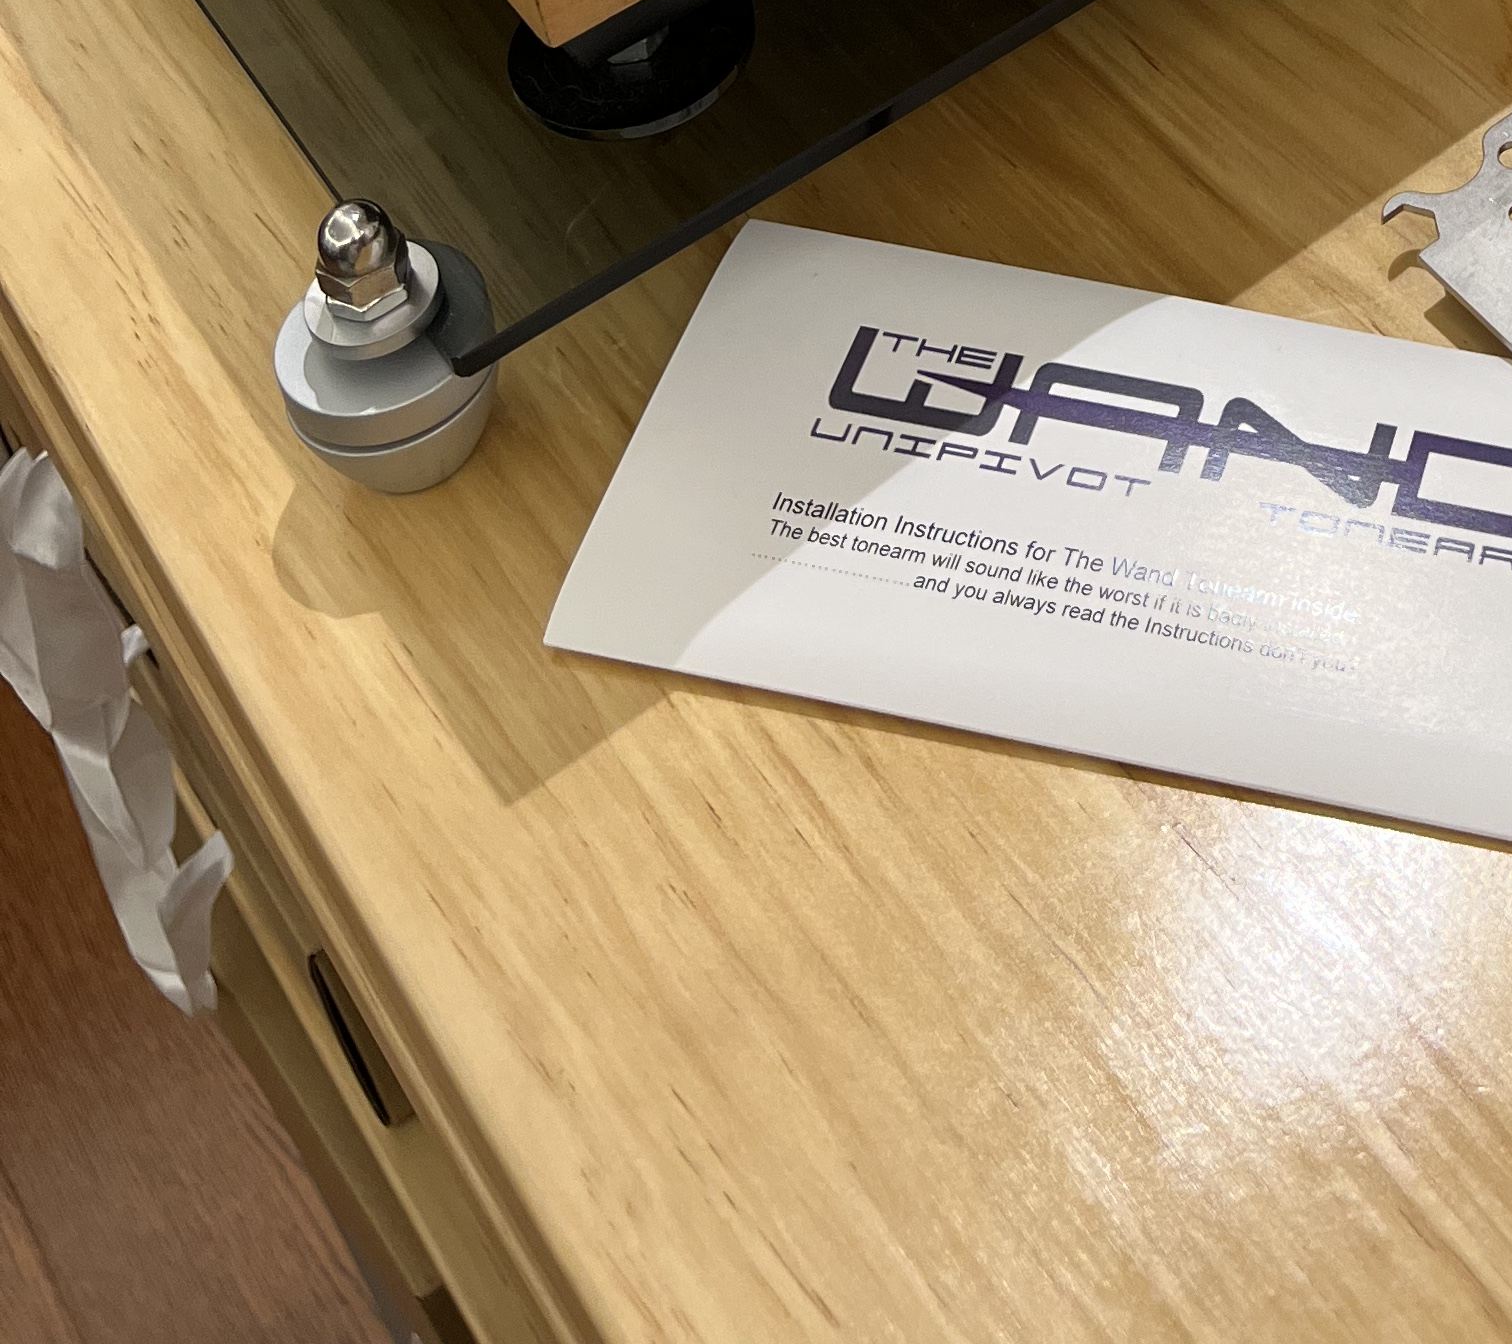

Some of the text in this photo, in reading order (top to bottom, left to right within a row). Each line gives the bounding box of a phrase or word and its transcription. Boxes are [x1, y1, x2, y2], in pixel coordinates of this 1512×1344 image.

[882, 330, 998, 370] THE
[809, 417, 1152, 497] UNIPIVOT
[769, 518, 804, 541] The
[807, 526, 849, 549] best
[851, 535, 926, 564] tonearm
[931, 552, 963, 572] will
[964, 560, 1024, 583] sound
[1026, 568, 1059, 590] like
[1063, 576, 1094, 596] the
[1098, 586, 1150, 608] worst
[1153, 593, 1168, 611] if
[1169, 599, 1183, 615] it
[1186, 603, 1202, 618] is
[771, 491, 889, 531] Installation
[894, 514, 1019, 557] Instructions
[1025, 540, 1057, 563] for
[1064, 546, 1104, 573] The
[1111, 556, 1179, 588] Wand
[952, 581, 988, 600] you
[992, 588, 1057, 616] always
[1061, 603, 1106, 624] read
[1109, 611, 1140, 631] the
[1144, 616, 1254, 654] Instructions
